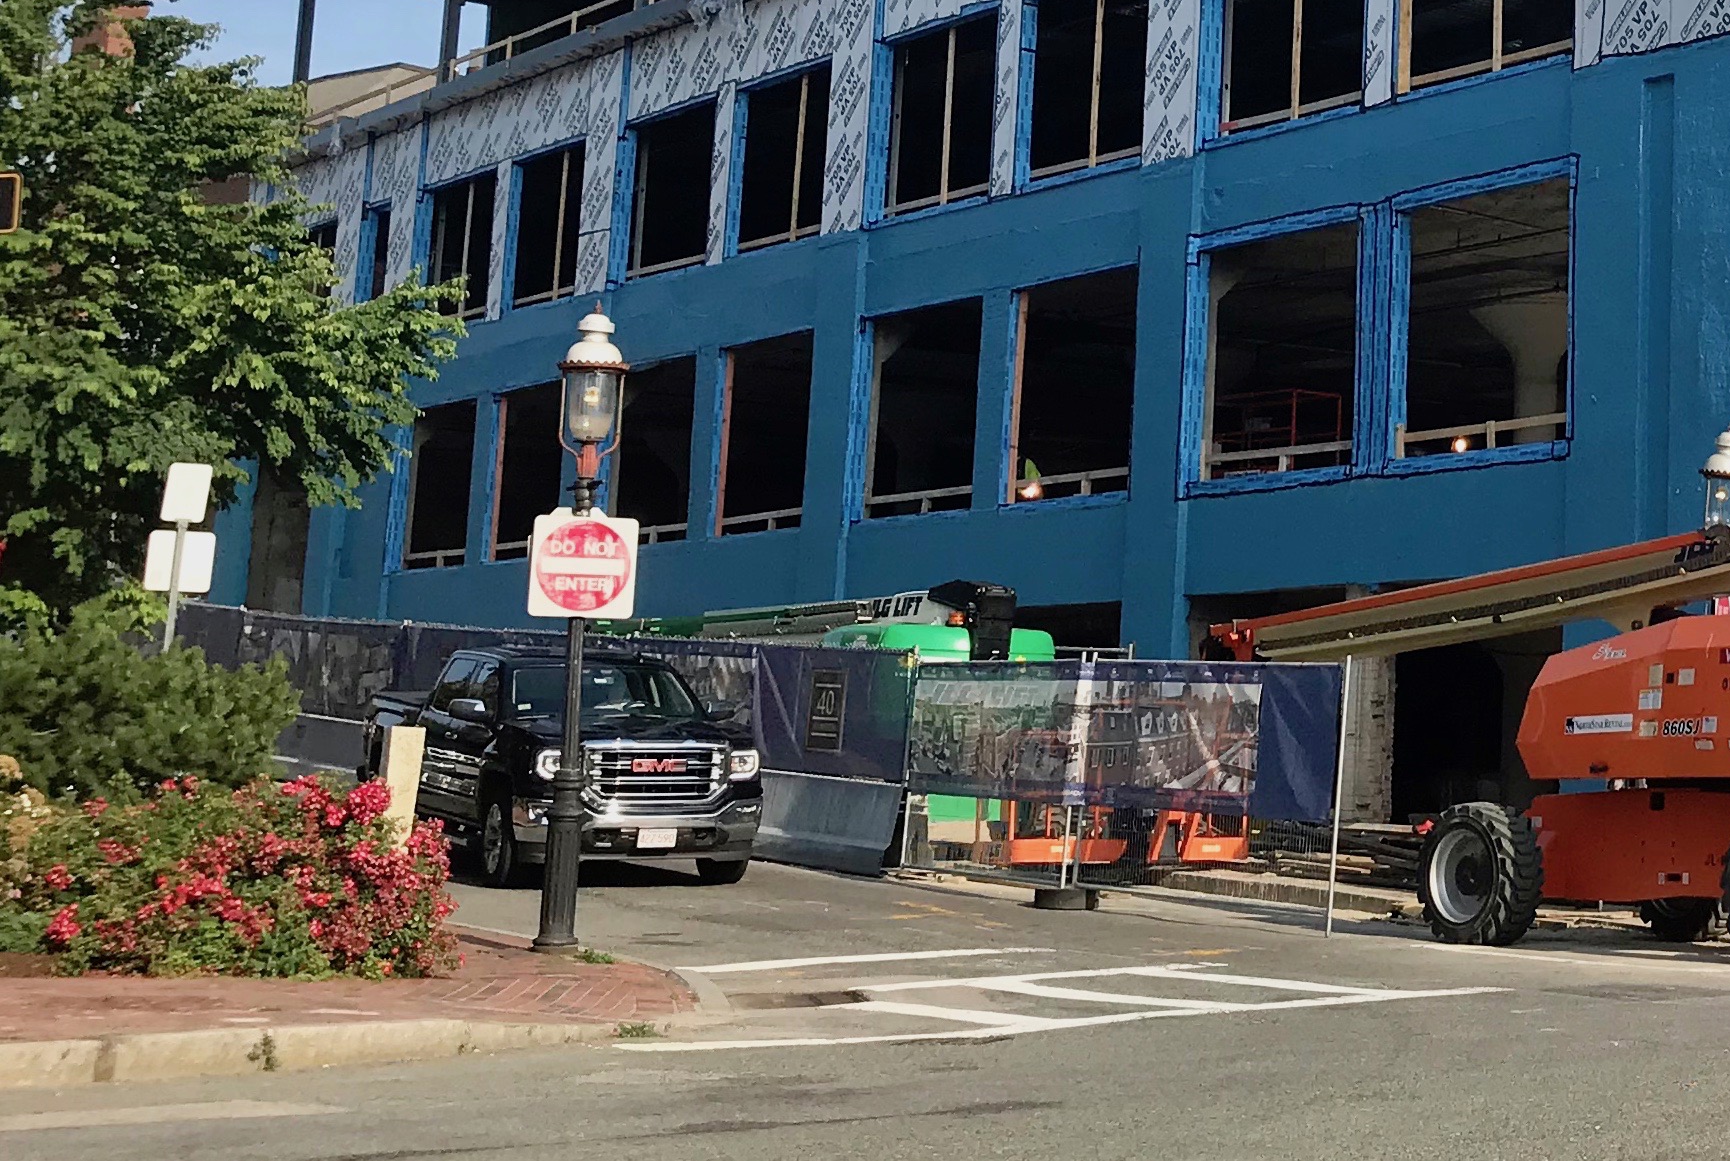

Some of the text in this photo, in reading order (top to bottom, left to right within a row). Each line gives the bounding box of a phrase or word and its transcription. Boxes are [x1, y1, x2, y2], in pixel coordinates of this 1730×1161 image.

[550, 539, 619, 557] DO NOT
[554, 576, 608, 592] ENTER
[893, 596, 923, 617] LIFT
[816, 690, 835, 715] 40
[631, 758, 688, 773] GMC
